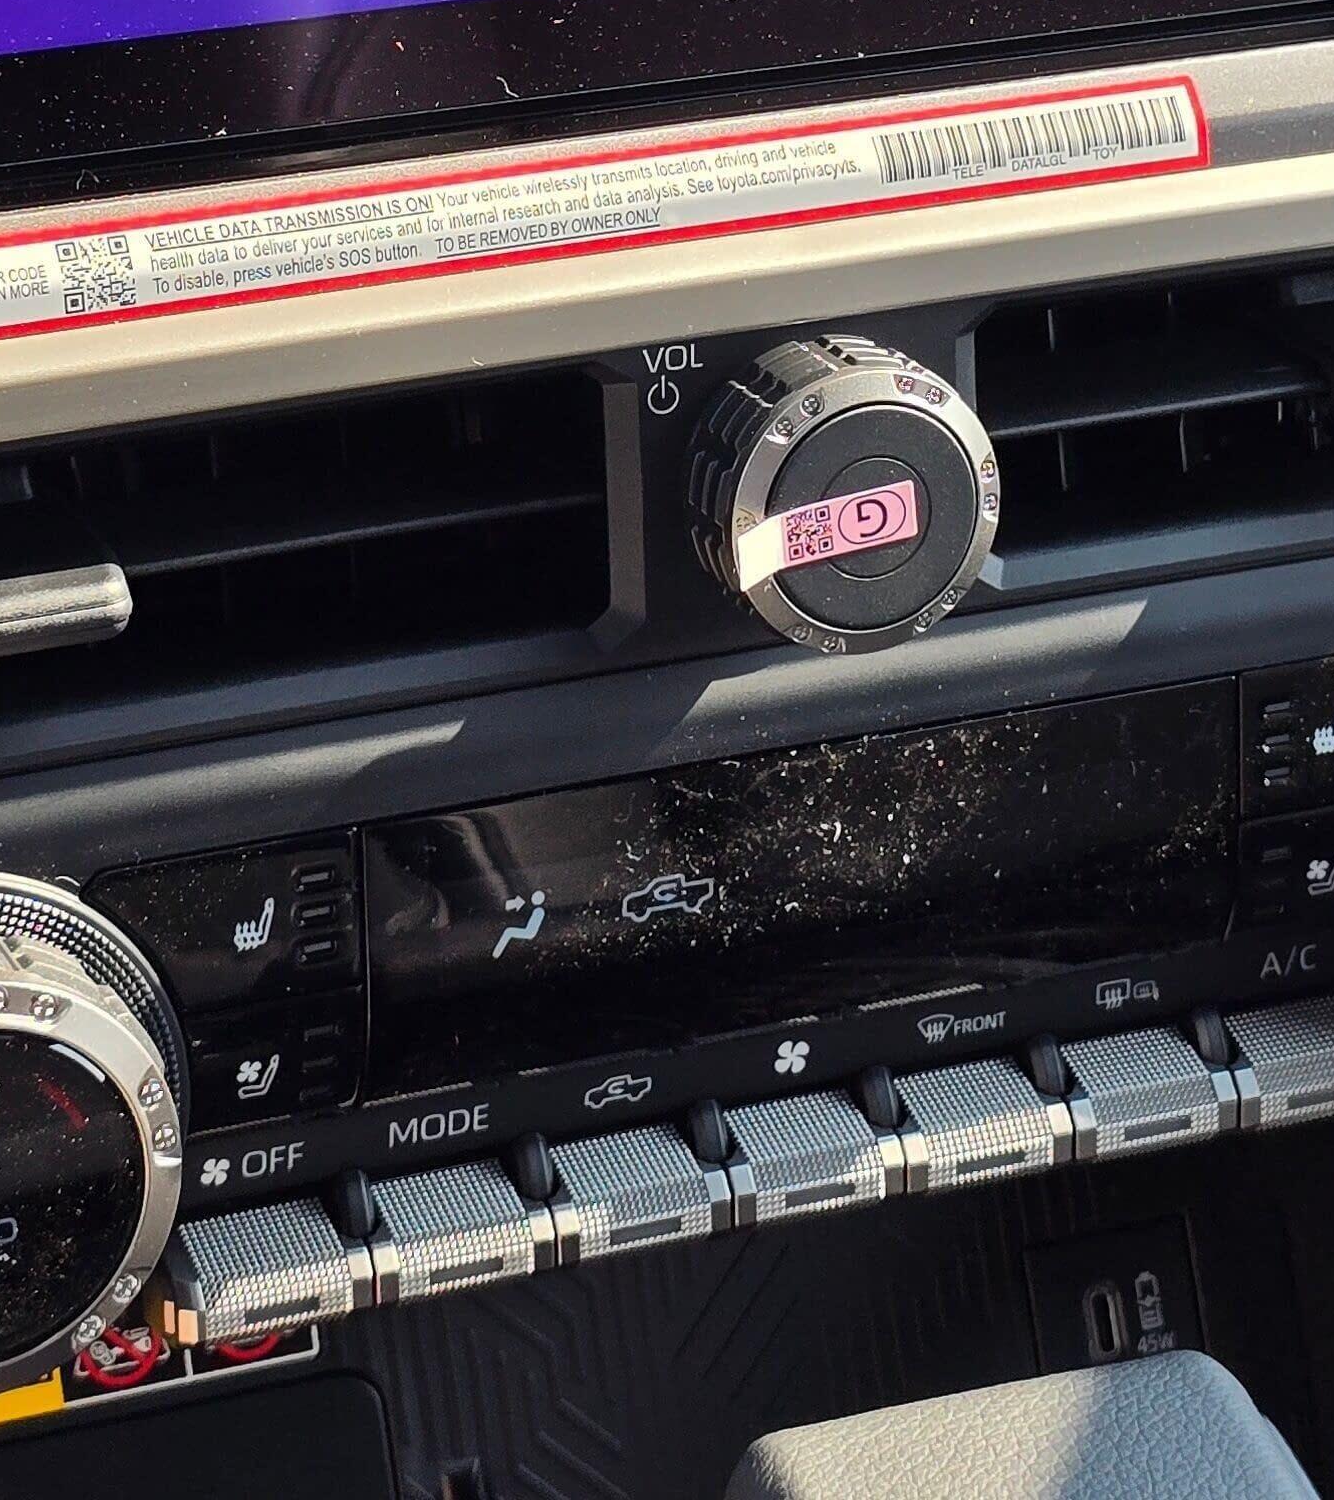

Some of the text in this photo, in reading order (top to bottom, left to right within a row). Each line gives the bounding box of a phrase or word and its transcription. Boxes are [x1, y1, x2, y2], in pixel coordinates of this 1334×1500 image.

[952, 164, 984, 181] TELE
[1093, 146, 1118, 161] TOY
[144, 140, 836, 249] VEHICLE DATA TRANSMISSION IS ON! Your vehicle wirelessly transmits location, driving and vehicle
[150, 249, 194, 272] health
[198, 245, 230, 264] data
[233, 243, 248, 260] to
[252, 236, 297, 259] deliver
[302, 232, 332, 256] your
[336, 225, 393, 247] services
[397, 219, 423, 237] and
[426, 215, 445, 233] for
[448, 206, 498, 229] internal
[502, 197, 561, 221] research
[565, 193, 590, 212] and
[593, 189, 622, 208] data
[627, 180, 684, 205] analysis.
[687, 176, 714, 195] See
[153, 277, 170, 295] To
[174, 267, 229, 292] disable,
[233, 263, 272, 287] press
[339, 248, 372, 268] SOS
[434, 236, 455, 254] TO
[458, 232, 477, 251] BE
[480, 222, 547, 247] REMOVED
[551, 219, 568, 238] BY
[571, 211, 622, 234] OWNER
[625, 207, 661, 227] ONLY
[8, 265, 47, 283] CODE
[10, 280, 50, 300] MORE
[642, 342, 703, 374] VOL
[1260, 943, 1317, 980] A/C
[953, 1011, 1006, 1037] FRONT
[388, 1102, 491, 1148] MODE
[241, 1141, 305, 1178] OFF
